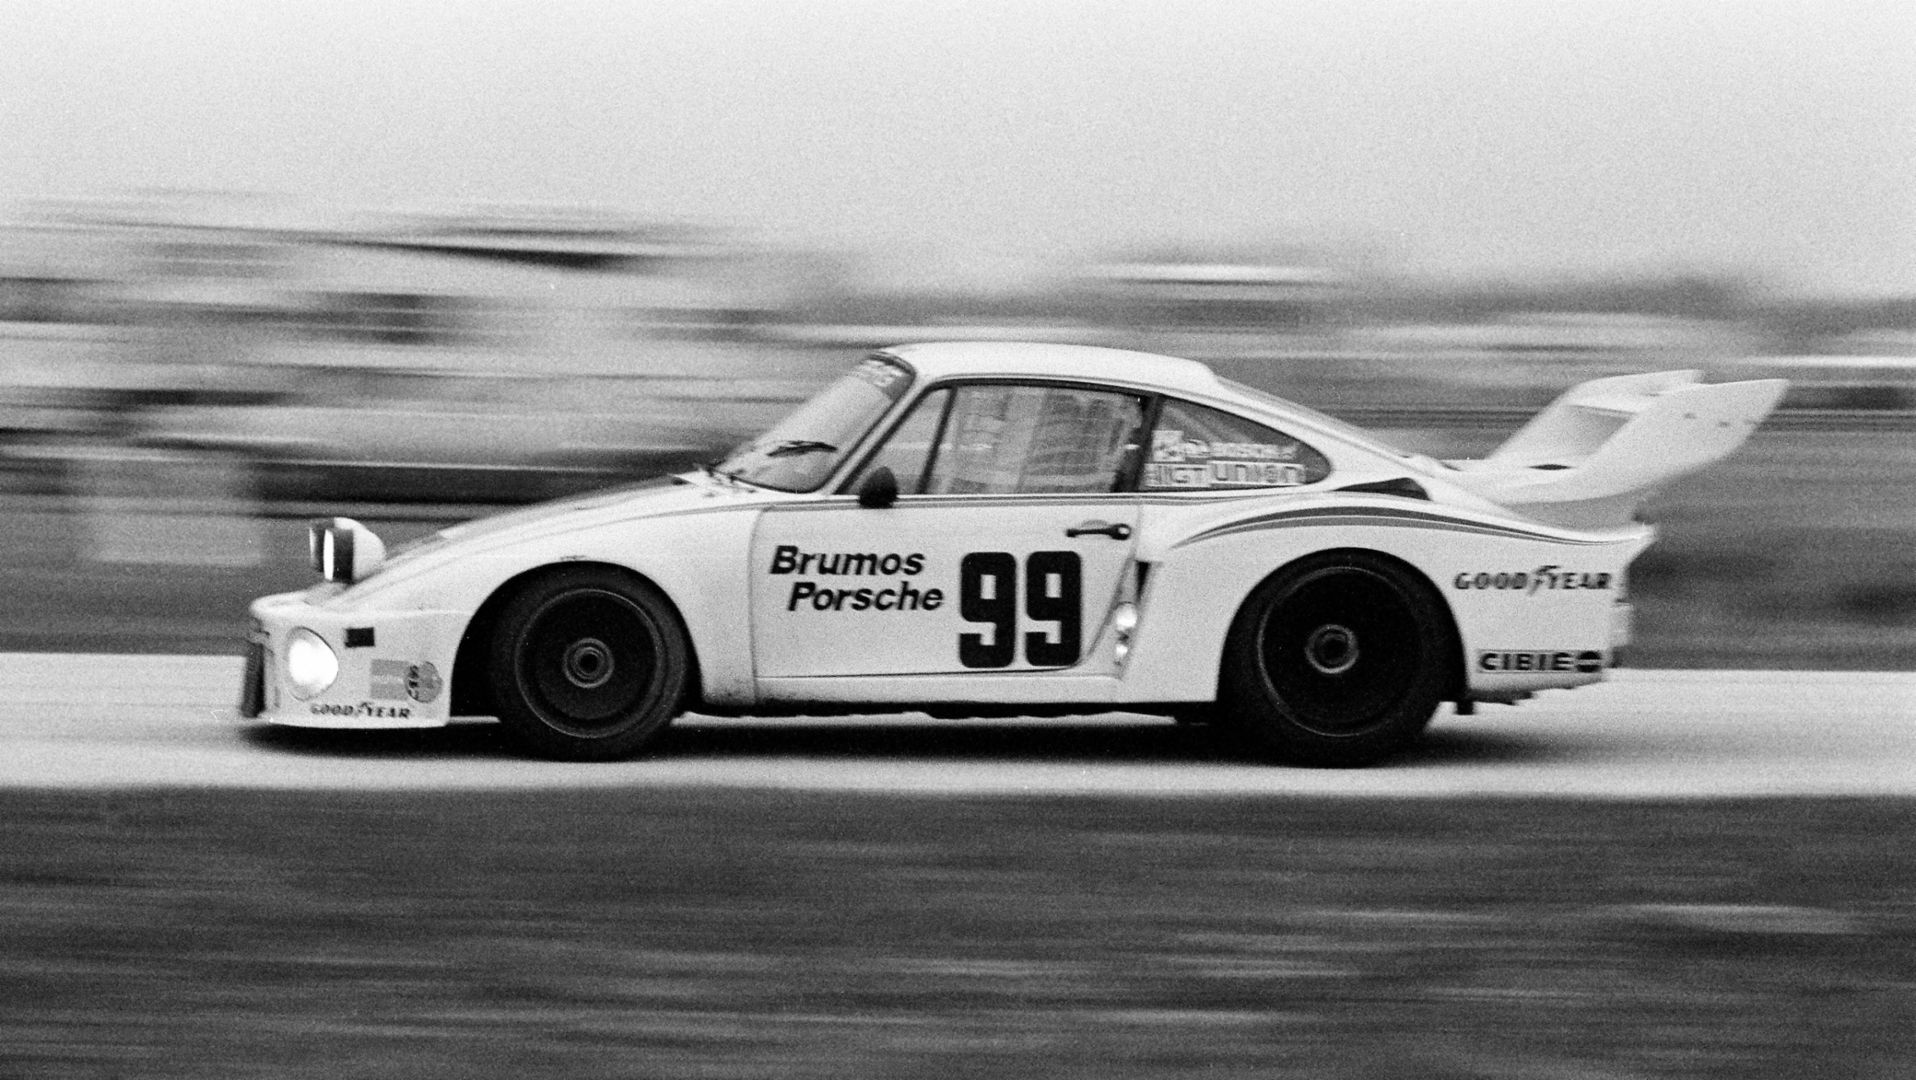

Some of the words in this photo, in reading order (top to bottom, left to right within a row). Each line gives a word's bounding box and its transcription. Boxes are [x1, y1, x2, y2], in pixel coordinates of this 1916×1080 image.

[770, 545, 926, 576] Brumos
[787, 581, 944, 612] Porsche
[958, 551, 1081, 668] 99
[1479, 652, 1574, 671] CIBIE
